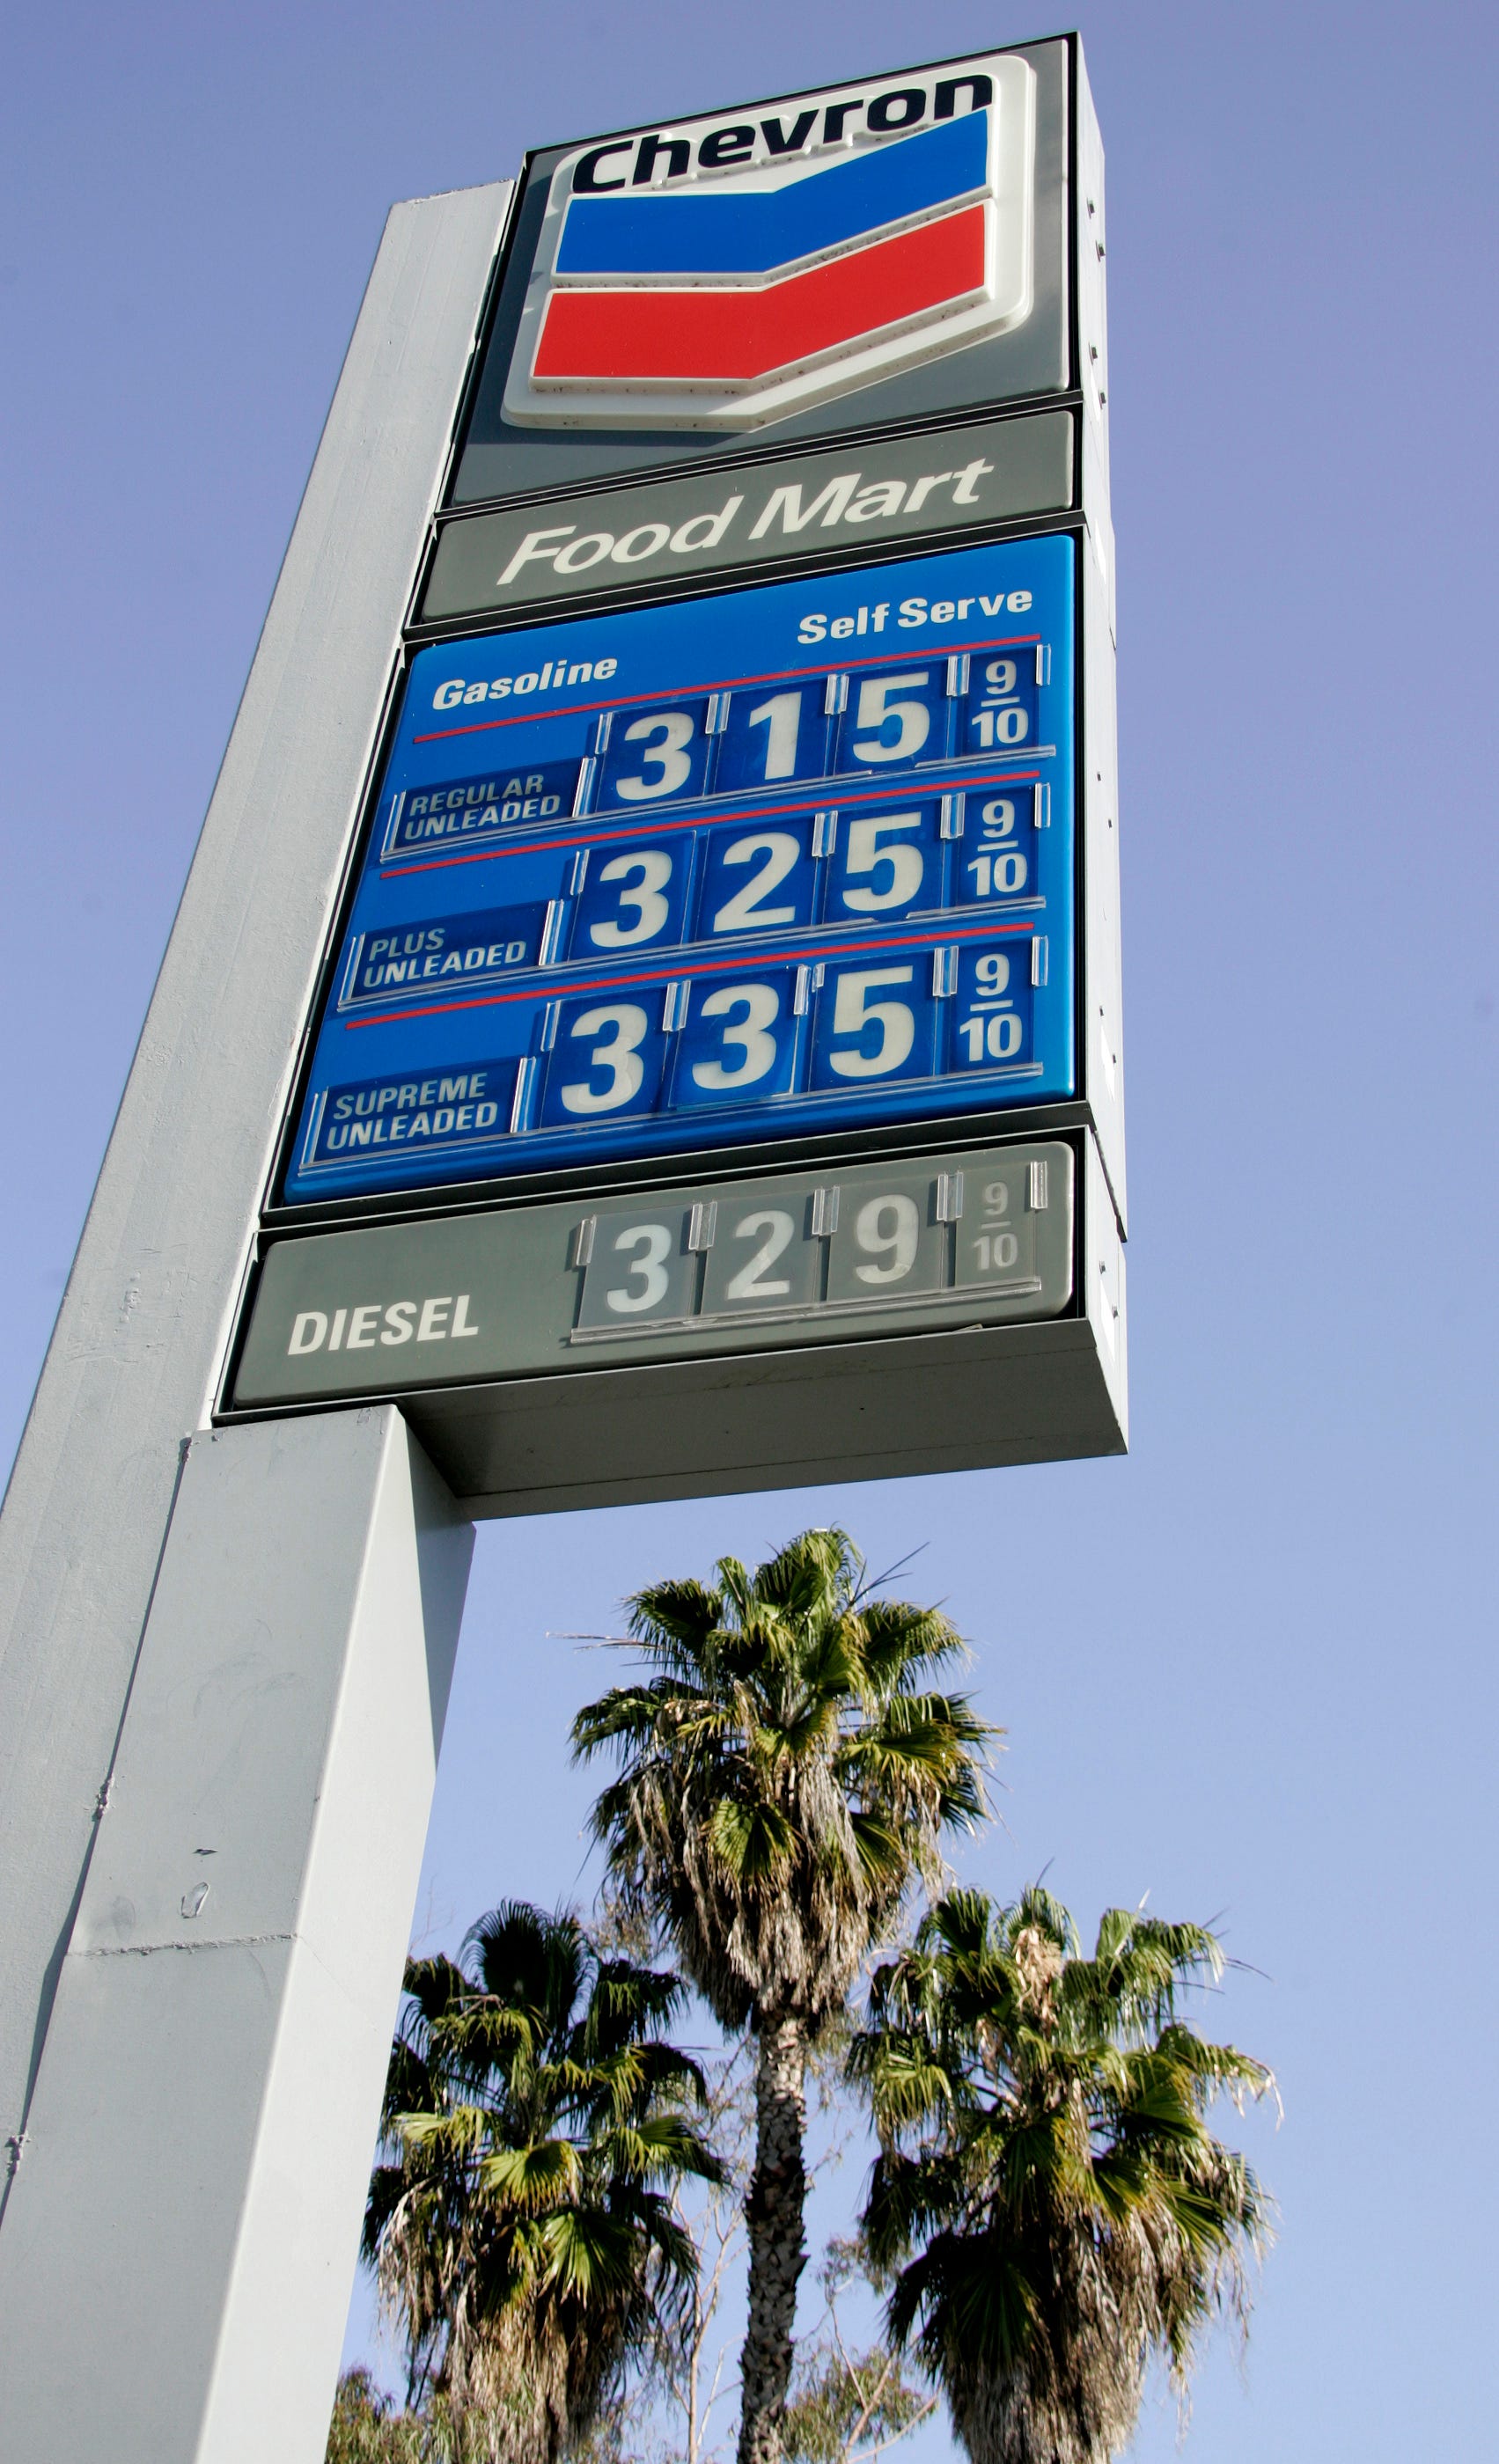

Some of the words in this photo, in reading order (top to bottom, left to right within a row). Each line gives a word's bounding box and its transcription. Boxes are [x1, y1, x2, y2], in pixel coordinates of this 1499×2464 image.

[573, 75, 992, 194] Chevron
[496, 495, 744, 585] Food
[748, 458, 994, 539] Mart
[797, 605, 891, 644] Self
[898, 590, 1032, 627] Serve
[432, 658, 618, 710] Gasoline
[985, 659, 1017, 696] 9
[971, 707, 1029, 748] 10
[409, 774, 544, 817] REGULAR
[404, 796, 561, 841] UNLEADED
[981, 800, 1016, 839] 9
[967, 852, 1028, 897] 10
[363, 941, 527, 988] UNLEADED
[368, 928, 445, 963] PLUS
[975, 954, 1009, 996] 9
[959, 1013, 1023, 1061] 10
[333, 1073, 488, 1120] SUPREME
[327, 1101, 498, 1150] UNLEADED
[983, 1182, 1009, 1215] 9
[973, 1233, 1018, 1270] 10
[288, 1295, 479, 1354] DIESEL
